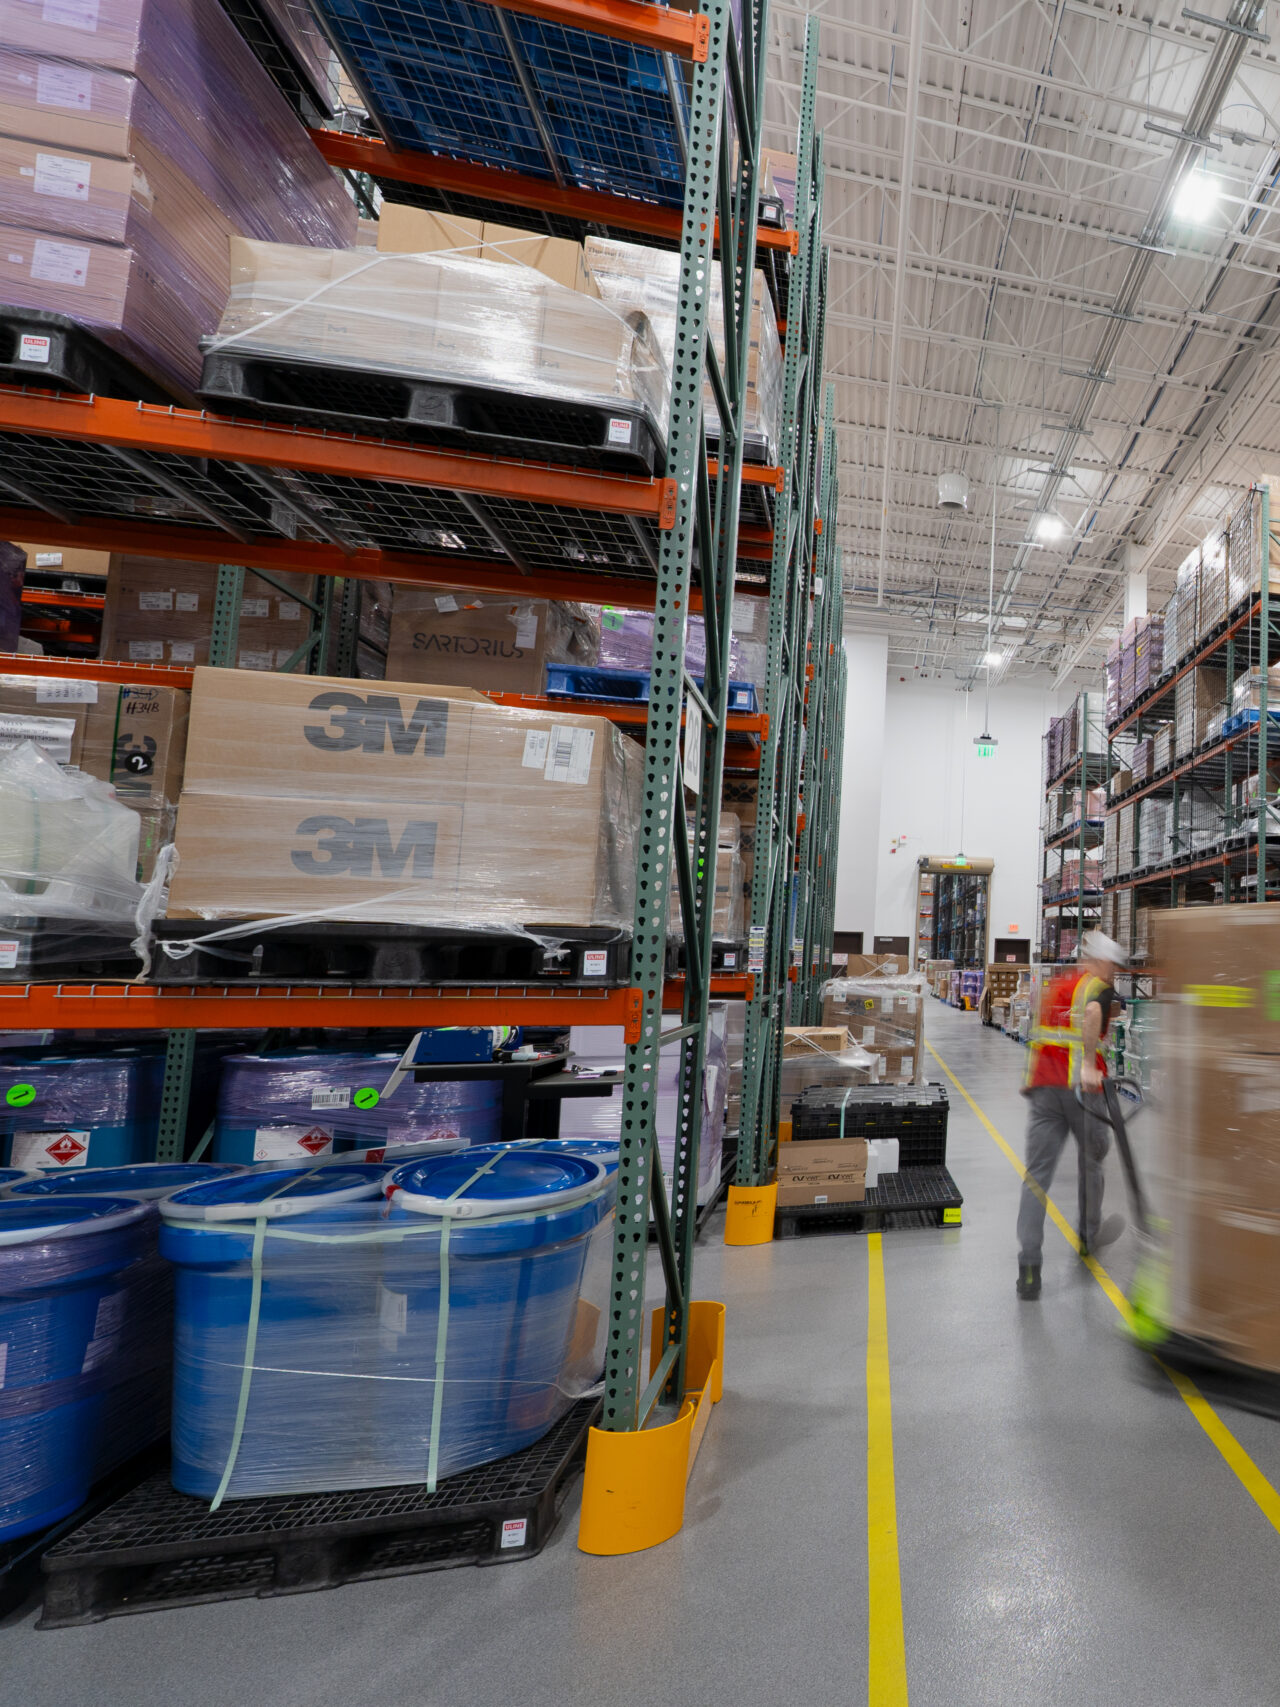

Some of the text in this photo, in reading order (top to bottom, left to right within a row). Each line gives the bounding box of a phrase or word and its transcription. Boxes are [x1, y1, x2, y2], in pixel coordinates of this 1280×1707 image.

[412, 632, 524, 658] SARTORIUS
[304, 691, 449, 758] 3M
[131, 756, 148, 770] 2
[291, 815, 438, 879] 3M
